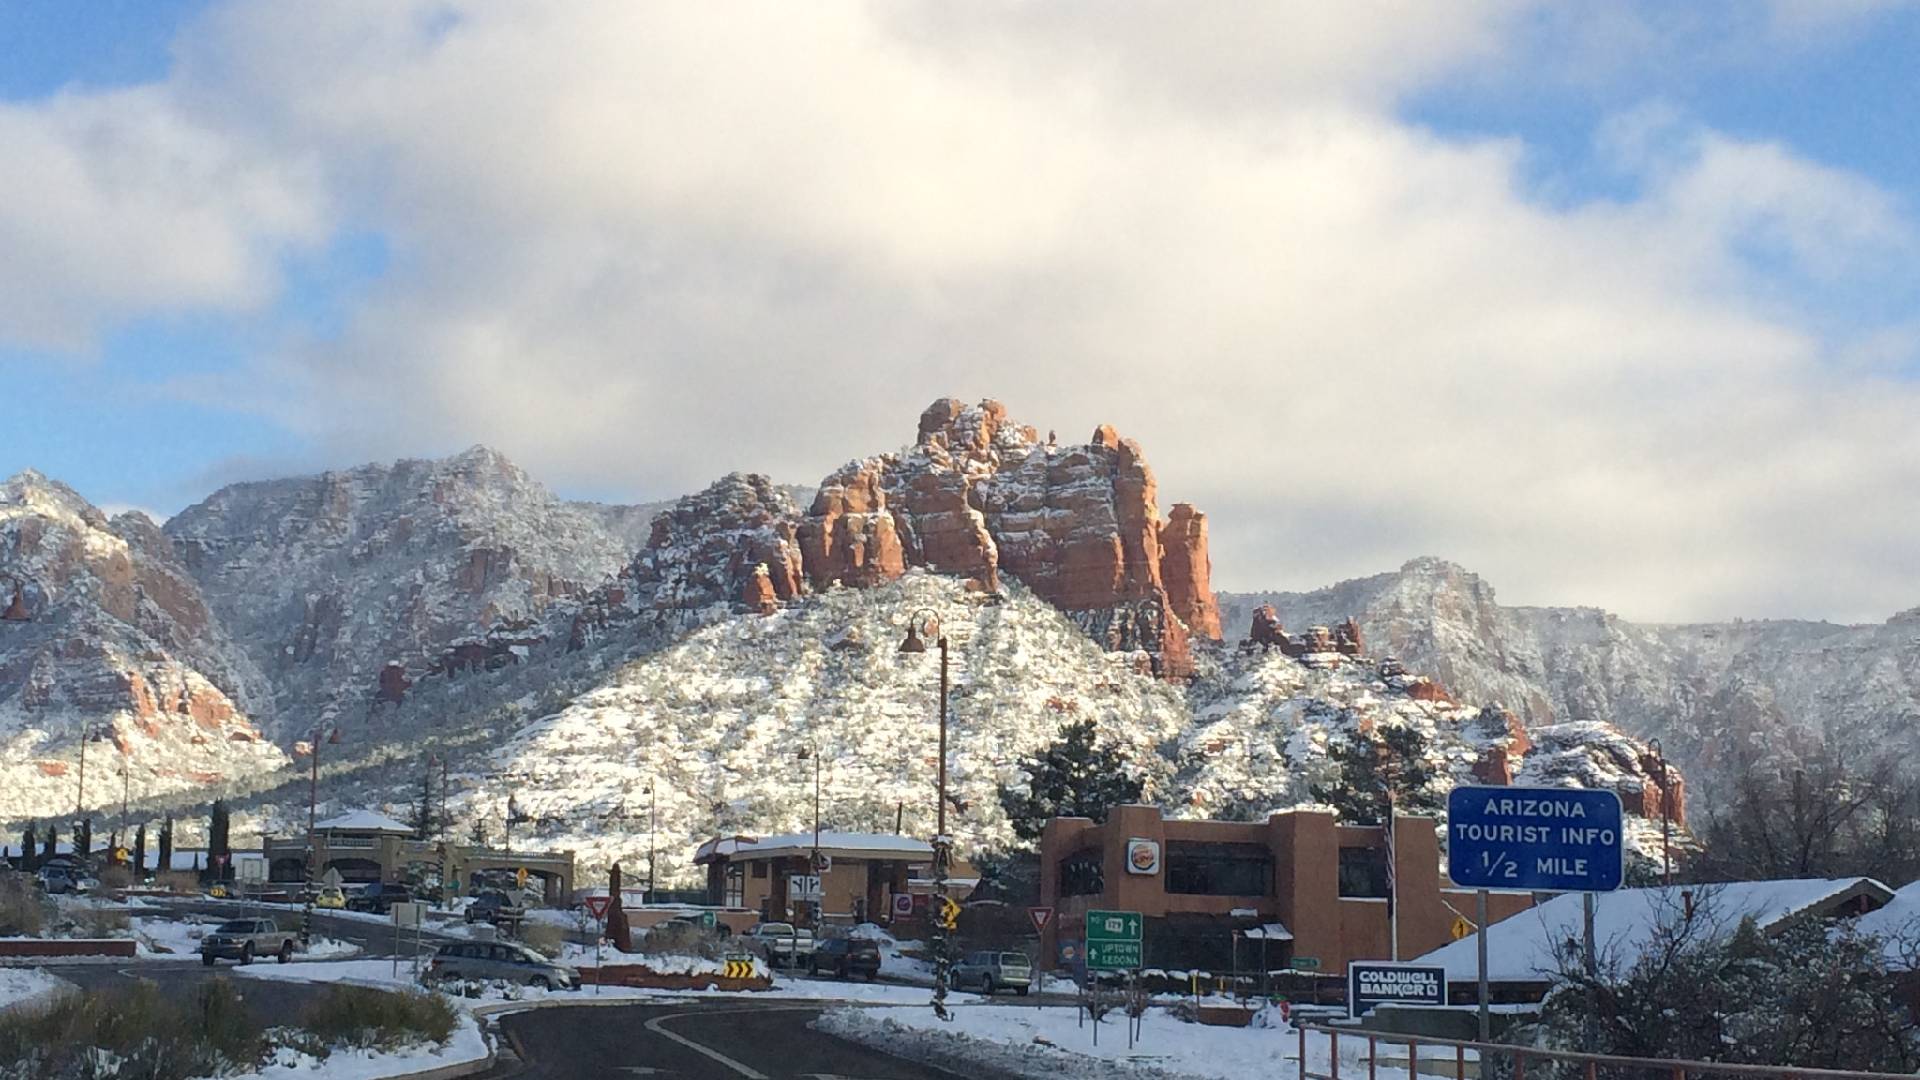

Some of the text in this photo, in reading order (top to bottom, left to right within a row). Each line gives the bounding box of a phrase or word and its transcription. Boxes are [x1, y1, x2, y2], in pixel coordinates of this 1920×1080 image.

[1484, 798, 1586, 818] ARIZONA
[1456, 824, 1614, 846] TOURIST INFO
[1481, 850, 1588, 878] 1/2 MILE
[1102, 943, 1139, 954] UPTOWN
[1102, 955, 1139, 965] SEDONA
